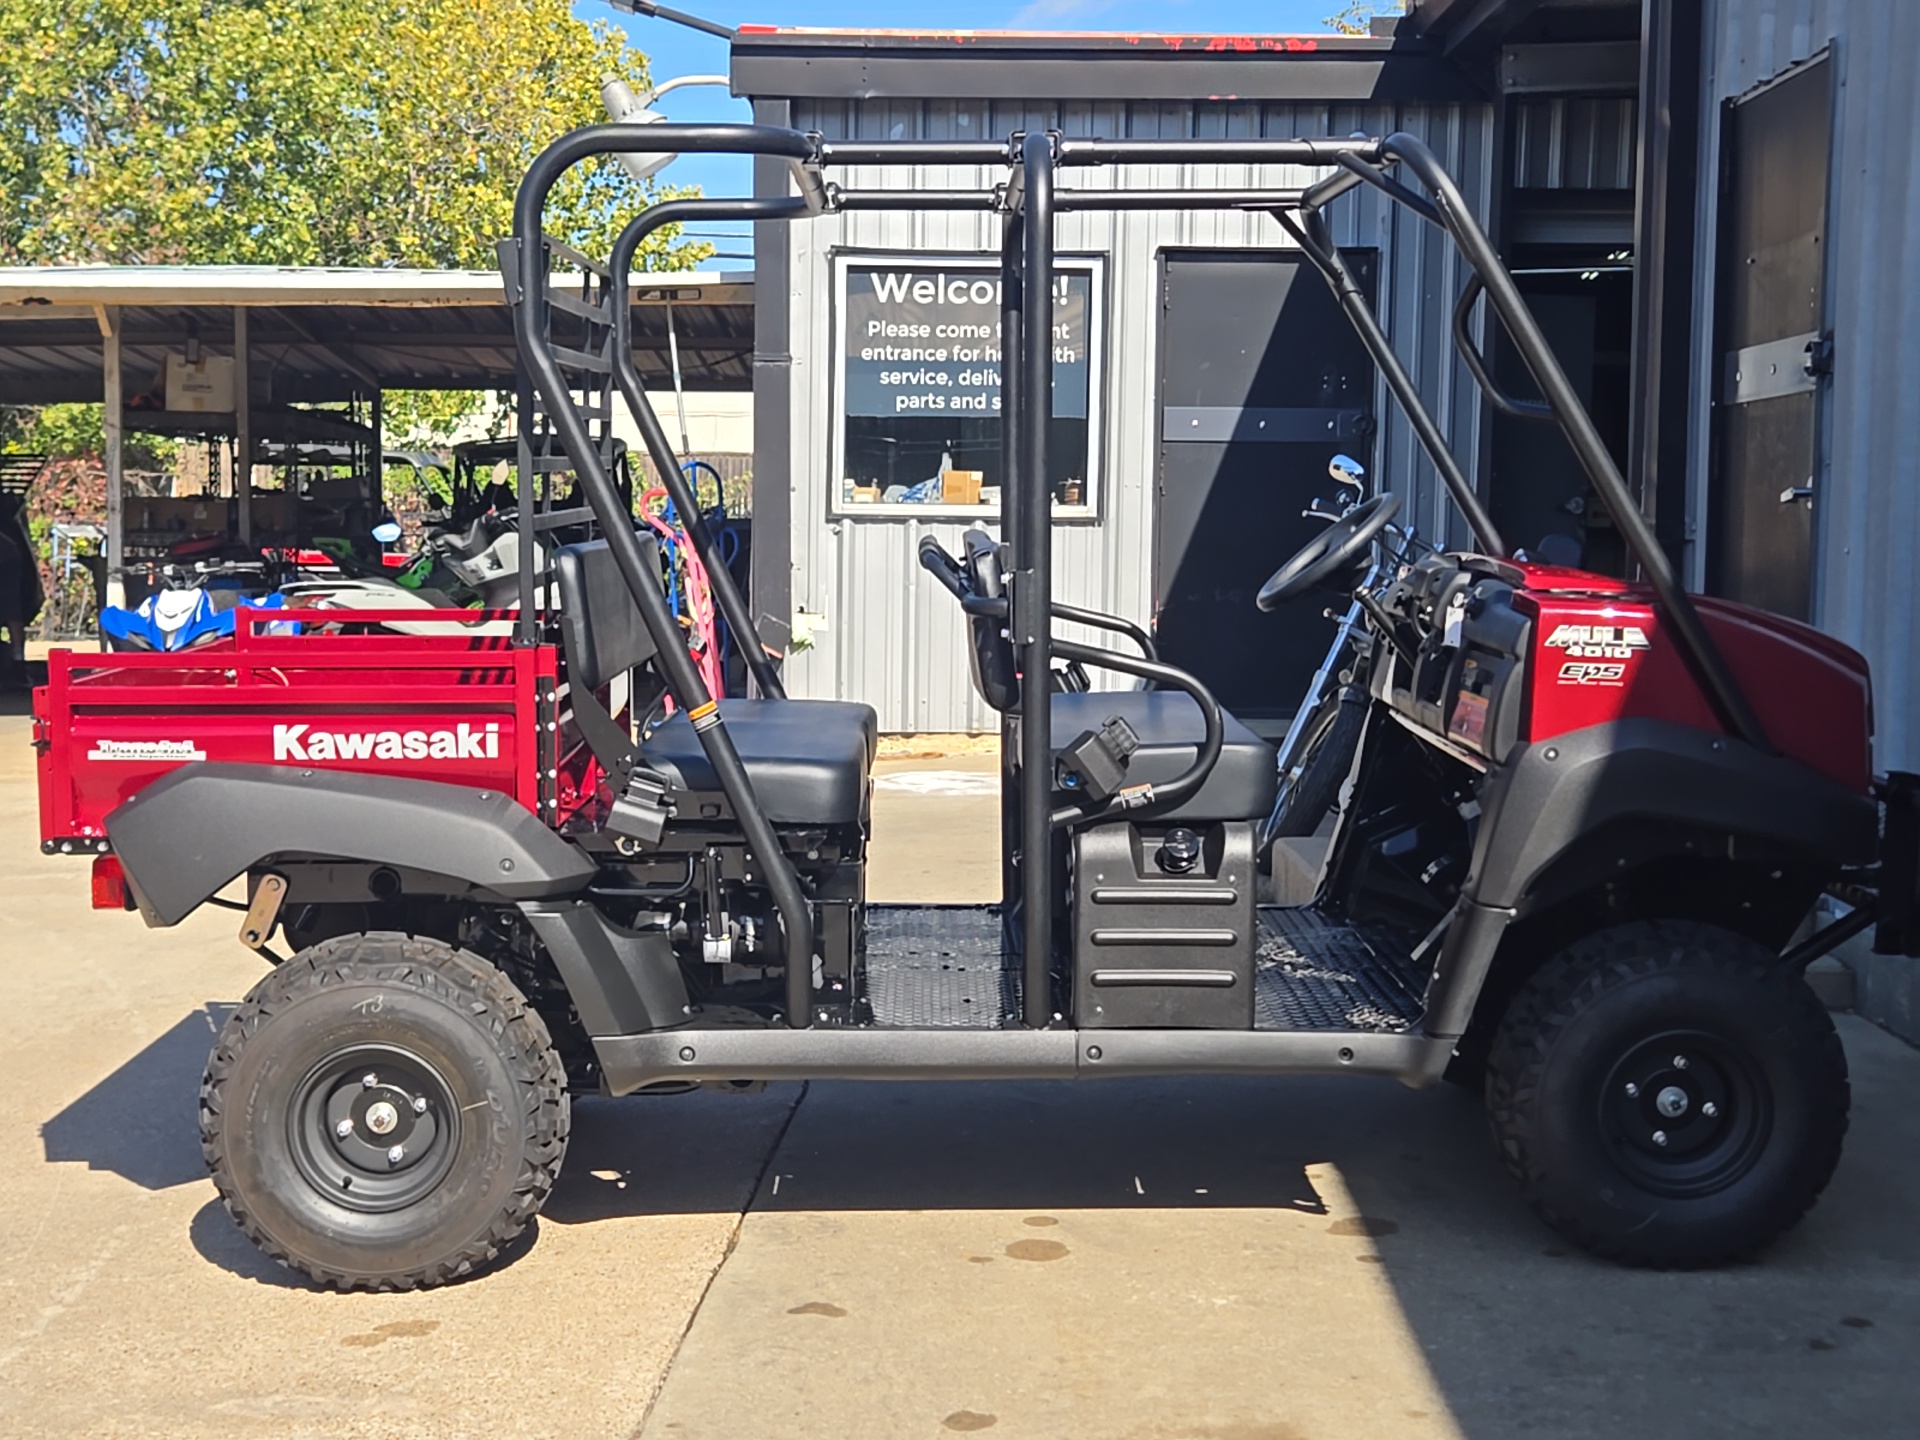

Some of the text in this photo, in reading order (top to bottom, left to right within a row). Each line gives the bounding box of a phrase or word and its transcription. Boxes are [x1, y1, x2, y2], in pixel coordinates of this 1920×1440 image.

[870, 272, 1069, 306] Welco!
[868, 320, 931, 338] Please
[936, 324, 991, 339] come
[861, 345, 948, 363] entrance
[953, 345, 979, 362] for
[879, 369, 953, 387] service,
[896, 393, 945, 412] parts
[950, 393, 986, 410] and
[1544, 624, 1651, 648] MULE
[1565, 646, 1632, 657] 4010
[273, 723, 499, 760] Kawasaki
